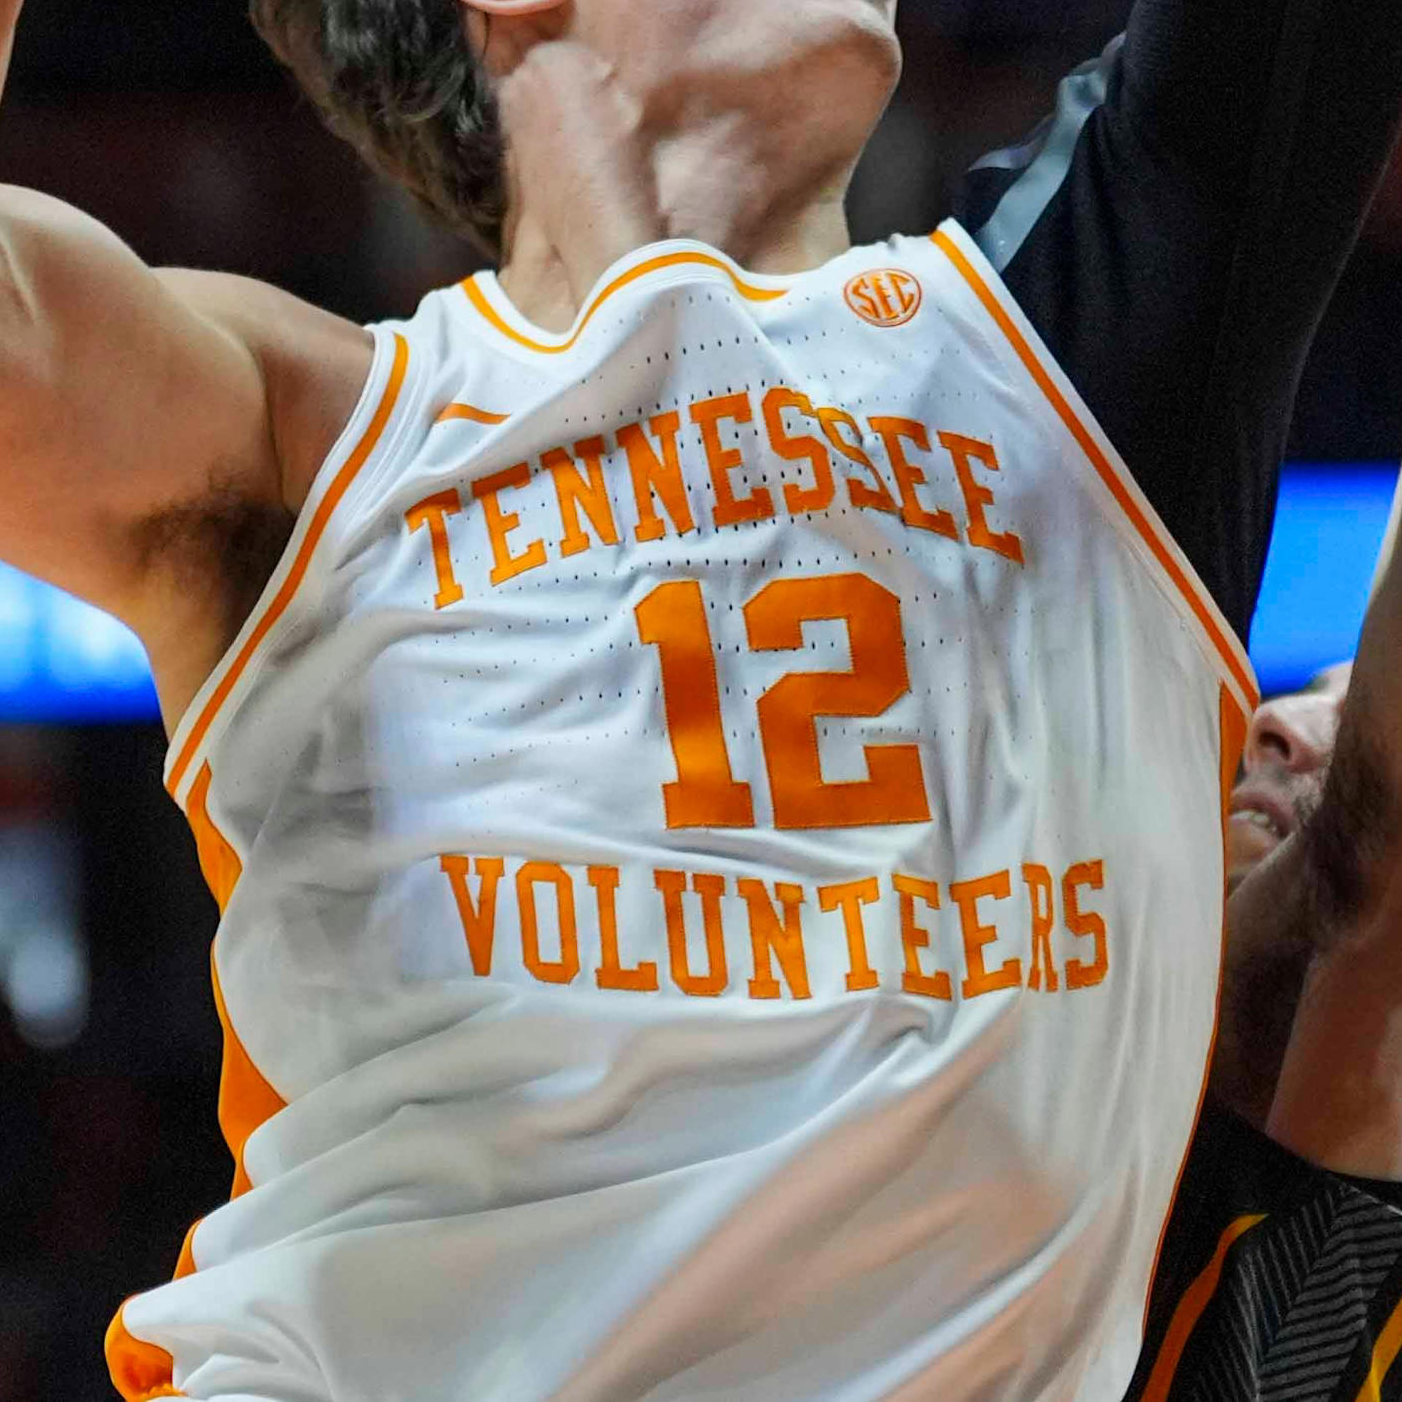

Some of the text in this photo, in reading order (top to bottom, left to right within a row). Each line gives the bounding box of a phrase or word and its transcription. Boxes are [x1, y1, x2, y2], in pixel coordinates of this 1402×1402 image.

[851, 272, 915, 319] SEC
[406, 386, 1025, 610] TENNESSEE
[633, 571, 931, 832] 12
[439, 854, 1109, 1001] VOLUNTEERS
